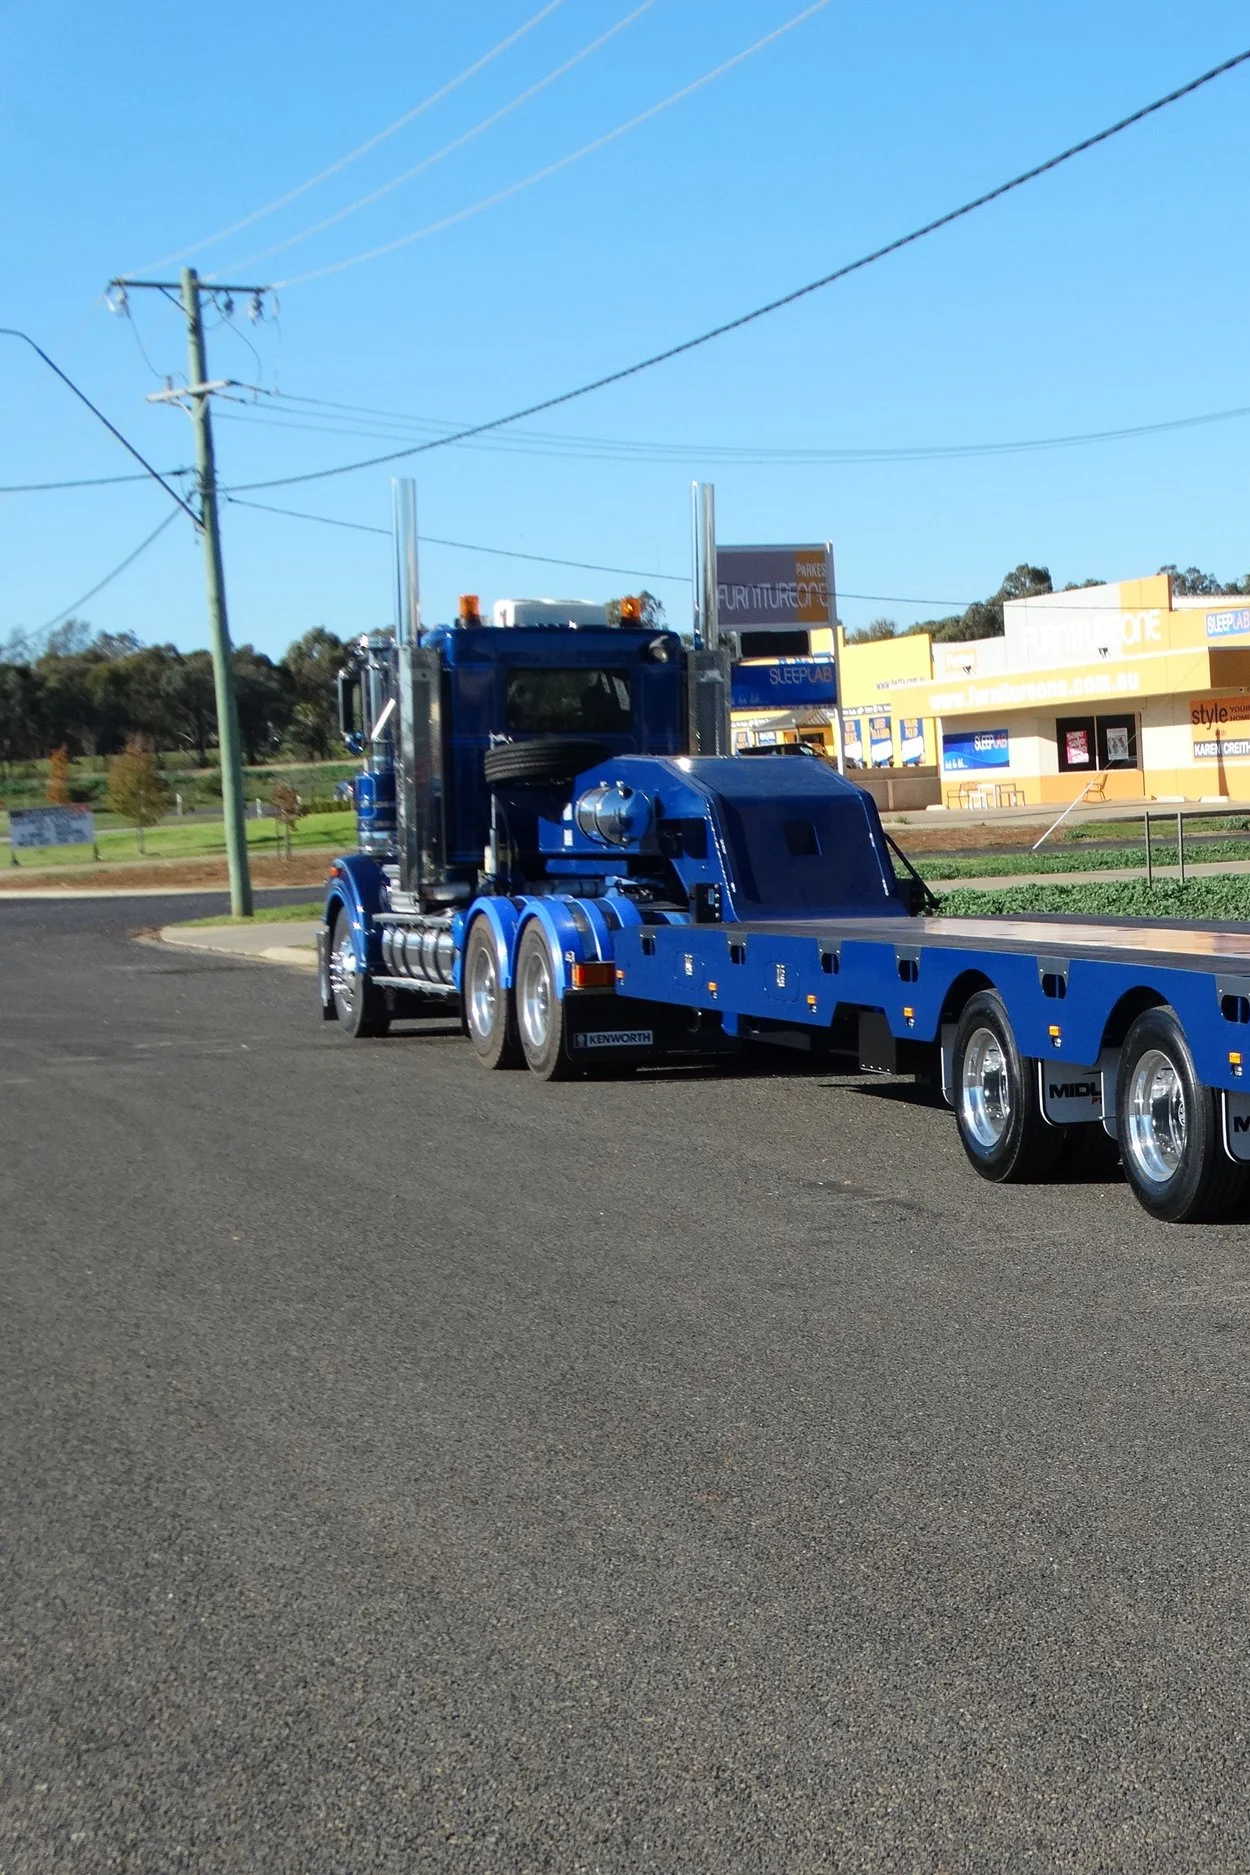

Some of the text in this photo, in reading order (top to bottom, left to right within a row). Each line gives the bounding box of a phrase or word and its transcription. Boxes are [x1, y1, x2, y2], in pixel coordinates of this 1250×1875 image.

[796, 563, 826, 577] PARKES
[1207, 611, 1250, 633] SLEEPLAB
[769, 666, 833, 685] SLEEPLAB
[1192, 703, 1228, 730] style
[1195, 743, 1221, 756] KAREN
[589, 1032, 651, 1044] KENWORTH
[1050, 1083, 1101, 1098] MIDL
